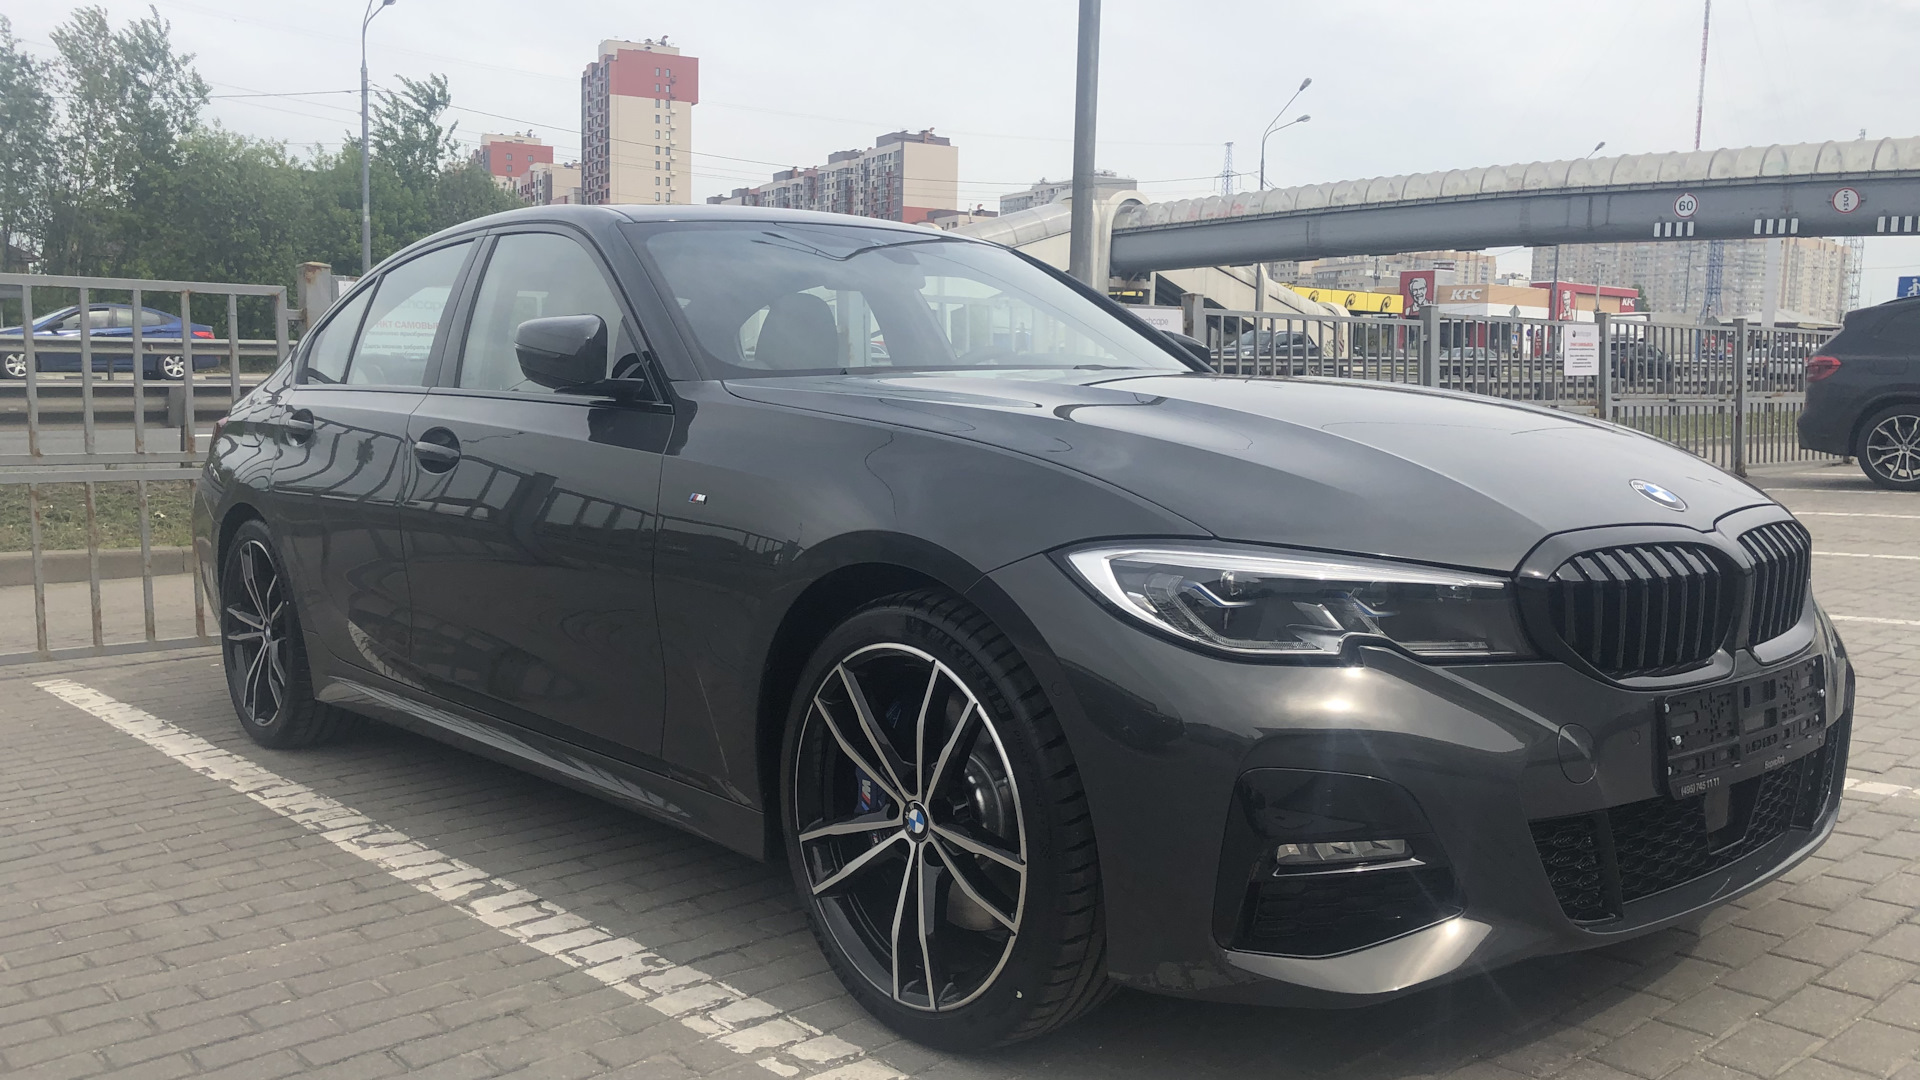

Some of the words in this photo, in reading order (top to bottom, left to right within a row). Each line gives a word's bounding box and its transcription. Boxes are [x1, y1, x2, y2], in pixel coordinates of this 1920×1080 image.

[1843, 194, 1849, 202] 5
[1679, 200, 1694, 211] 60
[1450, 289, 1483, 300] KFC
[1622, 297, 1635, 307] KFC
